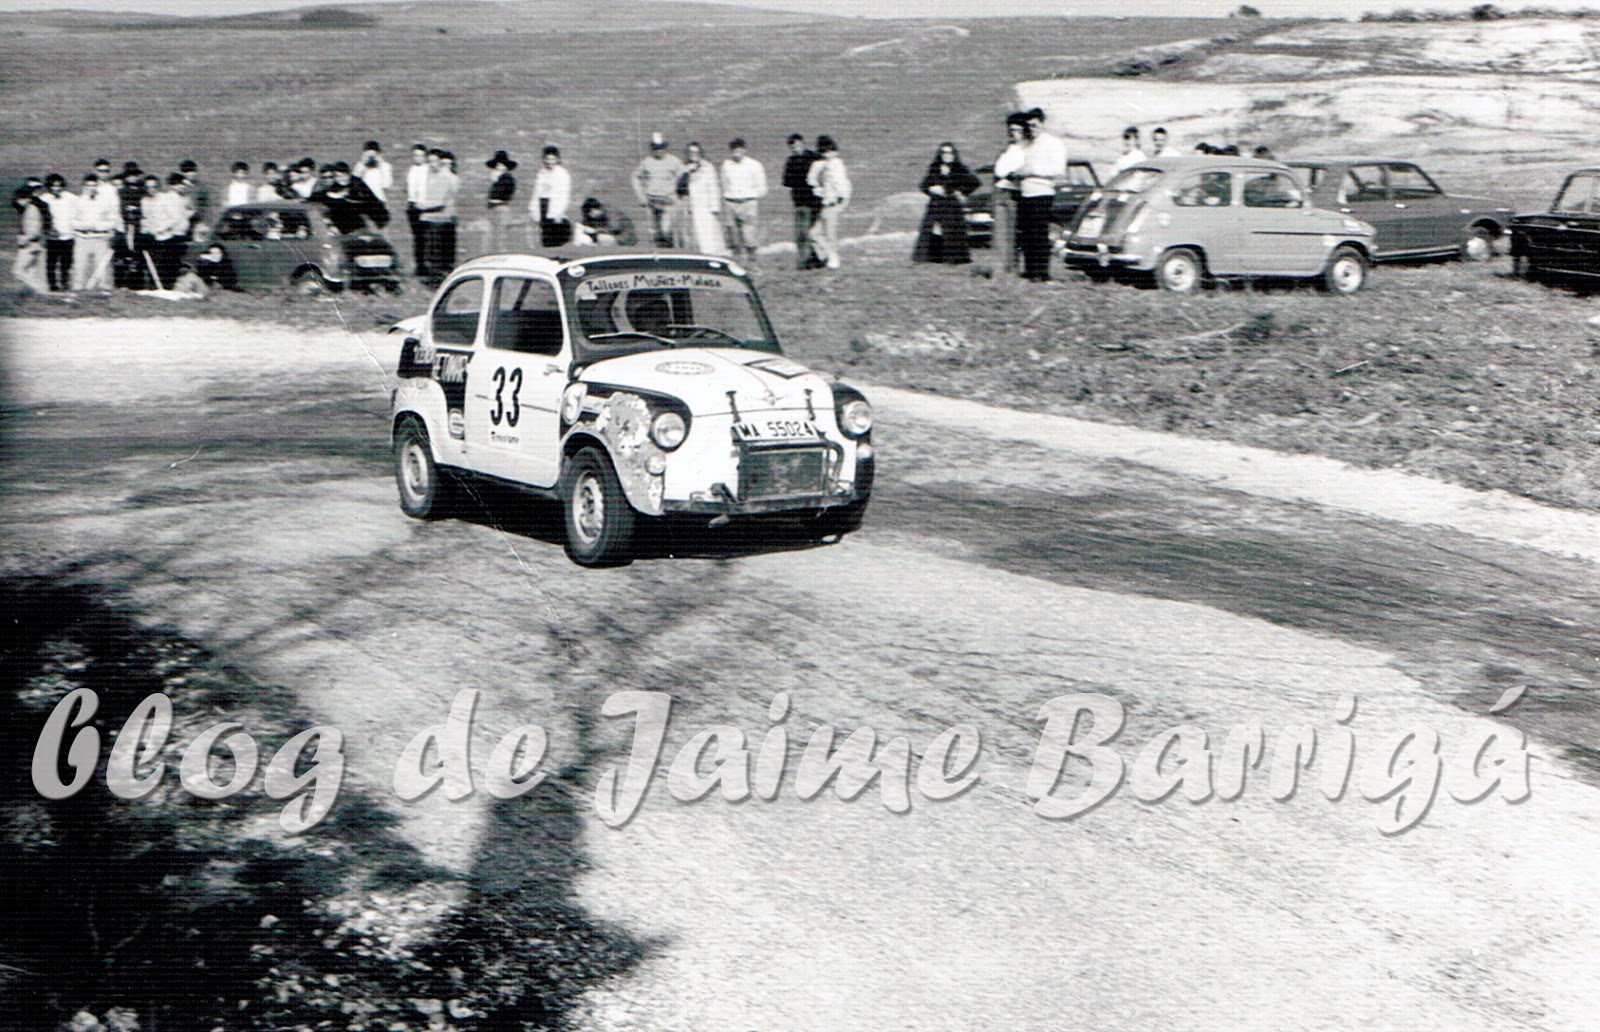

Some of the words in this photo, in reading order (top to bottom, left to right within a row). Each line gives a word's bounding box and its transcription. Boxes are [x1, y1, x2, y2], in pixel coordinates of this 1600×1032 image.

[490, 366, 523, 428] 33
[740, 426, 760, 438] MA
[767, 421, 814, 437] 55024
